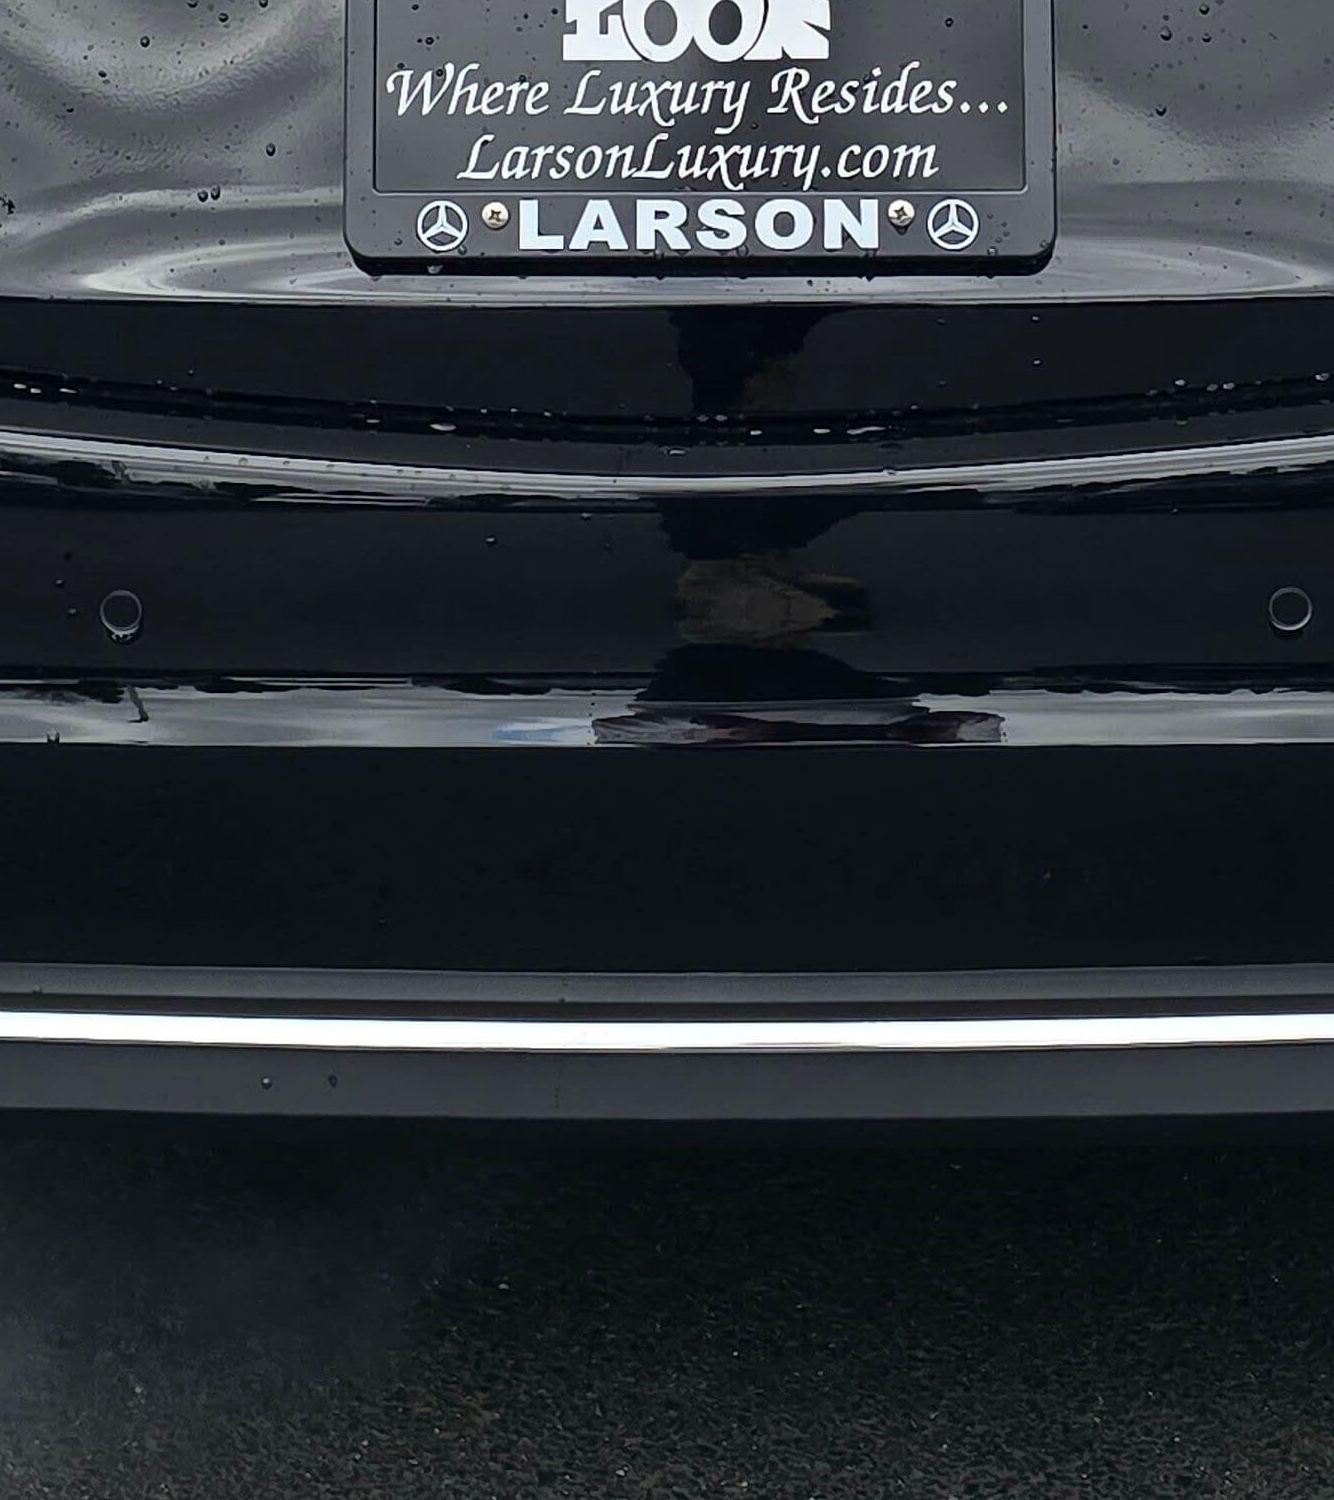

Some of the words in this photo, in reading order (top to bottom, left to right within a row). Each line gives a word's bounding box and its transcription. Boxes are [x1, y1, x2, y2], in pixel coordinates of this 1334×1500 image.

[385, 62, 550, 117] Where
[563, 69, 751, 134] Luxury
[766, 61, 1009, 125] Resides...
[456, 133, 940, 191] LarsonLuxury.com
[519, 198, 879, 252] LARSON
